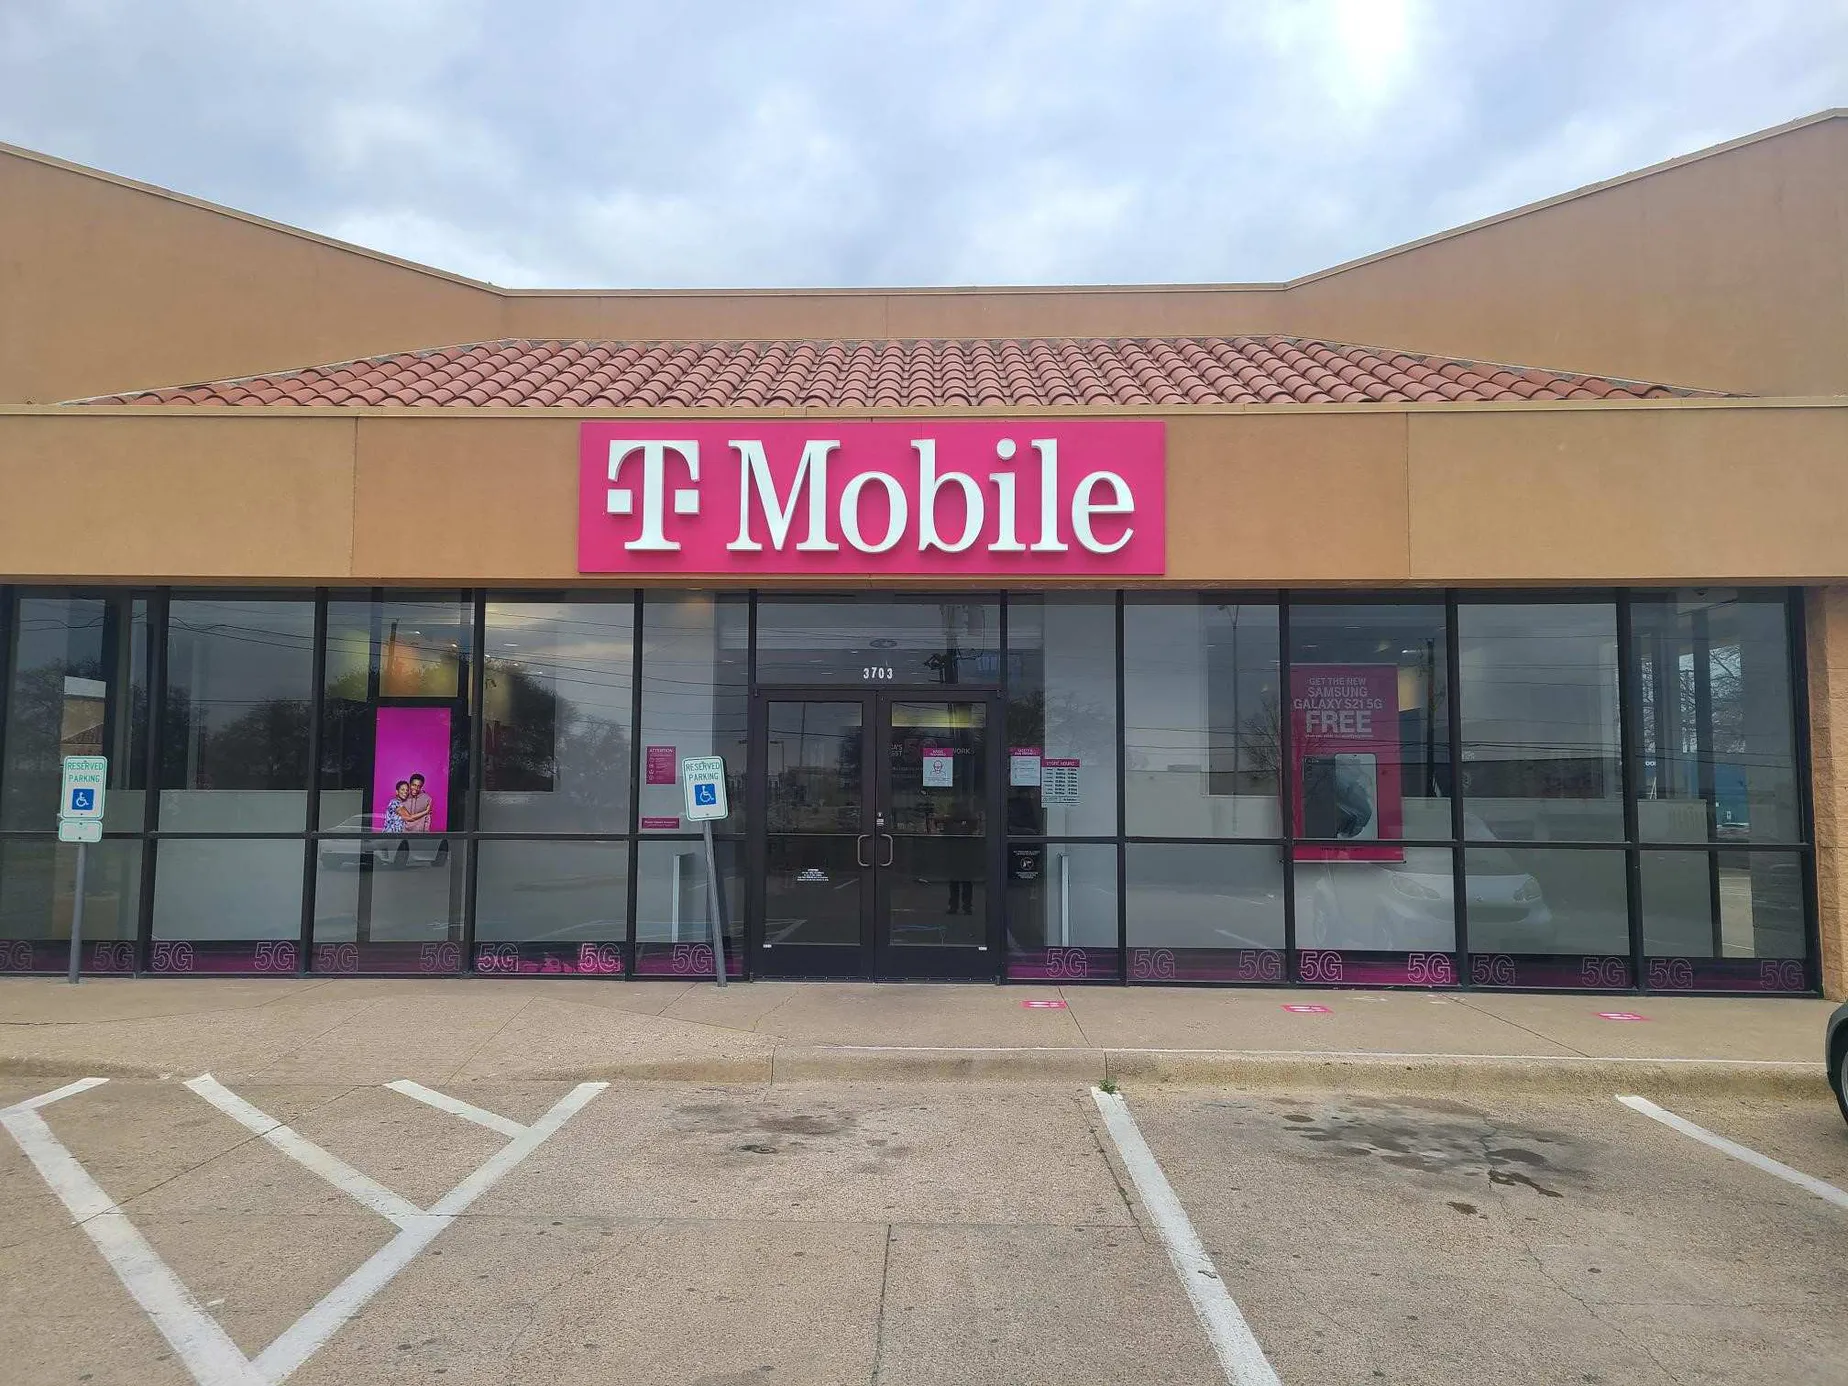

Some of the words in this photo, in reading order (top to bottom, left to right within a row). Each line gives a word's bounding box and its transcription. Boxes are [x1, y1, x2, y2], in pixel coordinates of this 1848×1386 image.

[726, 437, 1136, 555] Mobile
[863, 667, 893, 679] 3703
[1309, 677, 1326, 686] GET
[1328, 677, 1345, 686] THE
[1346, 677, 1366, 686] NEW
[1293, 698, 1343, 710] GALAXY
[1307, 686, 1368, 698] SAMSUNG
[1306, 710, 1372, 733] FREE
[67, 762, 104, 771] RESERVED
[68, 774, 100, 783] PARKING
[686, 761, 720, 772] RESERVED
[688, 773, 719, 781] PARKING
[93, 941, 134, 971] 5G
[153, 941, 193, 971] 5G
[255, 941, 295, 971] 5G
[319, 943, 359, 972] 5G
[420, 942, 460, 971] 5G
[478, 943, 518, 972] 5G
[580, 943, 620, 972] 5G
[673, 944, 712, 973] 5G
[1045, 948, 1087, 978] 5G
[1133, 949, 1175, 978] 5G
[1239, 950, 1281, 980] 5G
[1300, 951, 1342, 981] 5G
[1408, 953, 1451, 983] 5G
[1472, 955, 1515, 985] 5G
[1582, 957, 1626, 987] 5G
[1650, 958, 1693, 988] 5G
[1760, 960, 1805, 990] 5G
